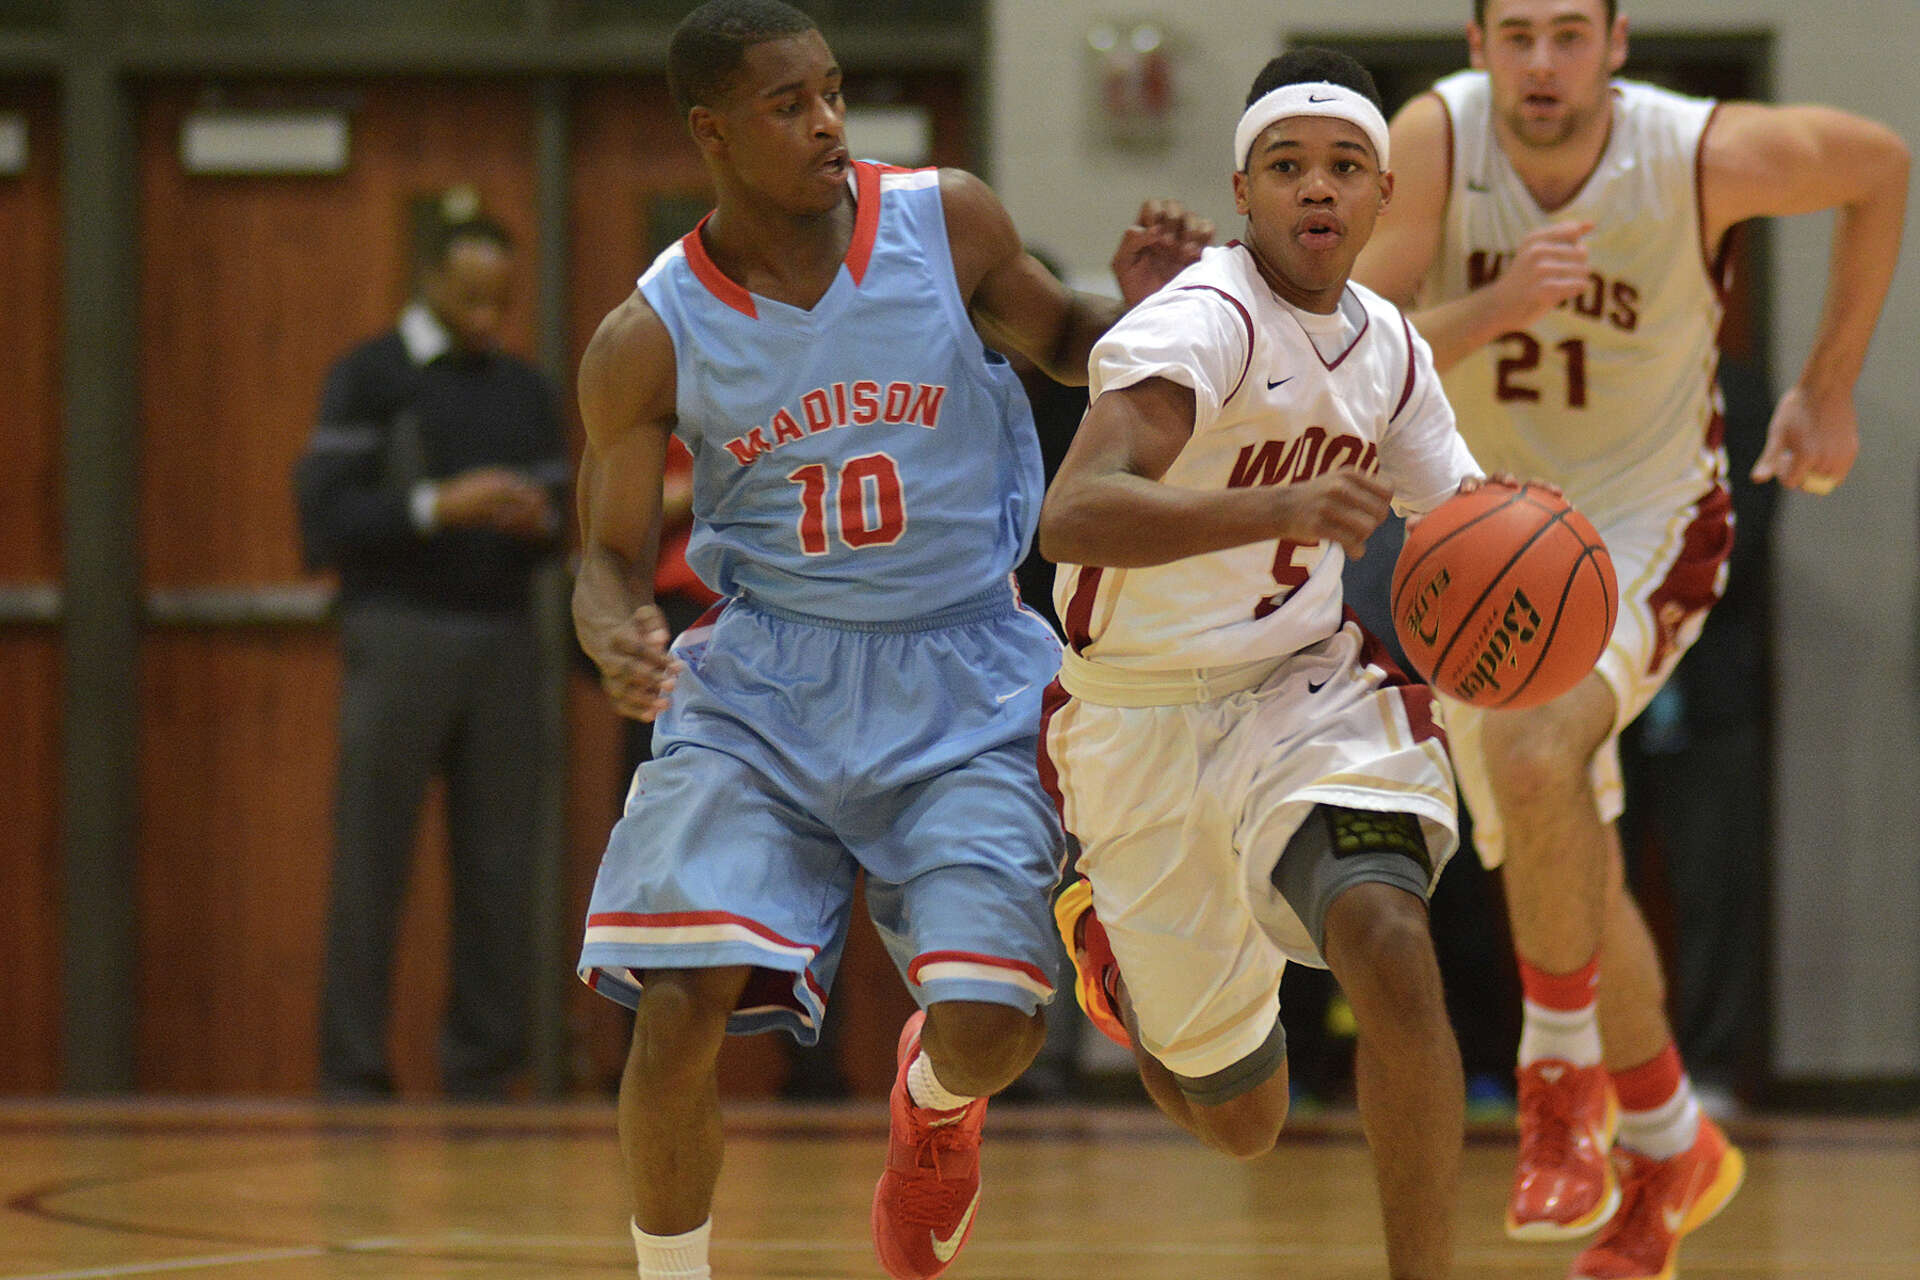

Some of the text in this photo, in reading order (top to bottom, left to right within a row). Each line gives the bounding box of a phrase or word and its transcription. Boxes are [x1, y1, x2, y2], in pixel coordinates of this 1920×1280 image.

[1495, 331, 1586, 408] 21
[723, 380, 947, 467] MADISON
[787, 451, 907, 556] 10
